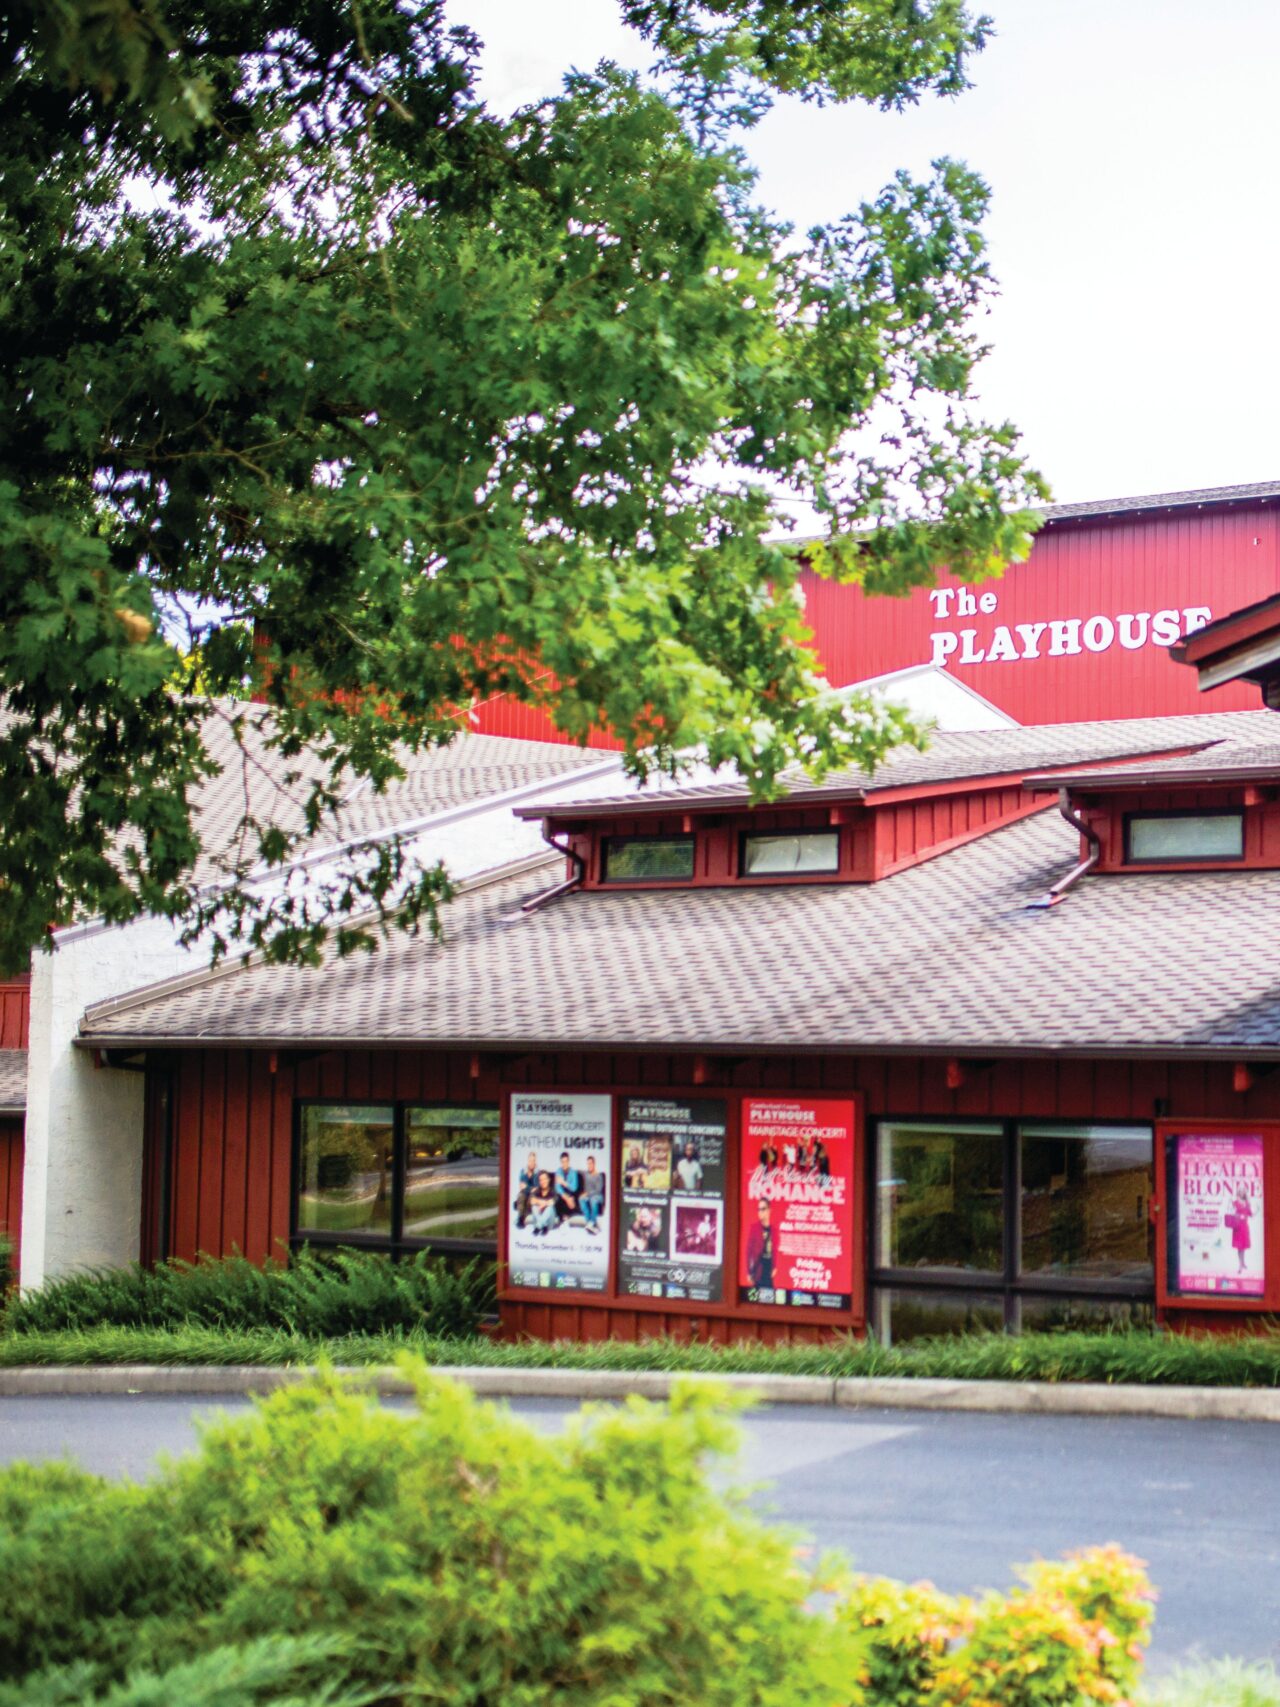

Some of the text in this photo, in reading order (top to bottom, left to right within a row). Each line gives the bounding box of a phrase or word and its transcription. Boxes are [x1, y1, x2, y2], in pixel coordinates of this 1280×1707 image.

[929, 586, 998, 618] The
[929, 606, 1213, 667] PLAYHOUSE
[516, 1104, 573, 1113] PLAYHOUSE
[628, 1107, 690, 1118] PLAYHOUSE
[750, 1110, 815, 1120] PLAYHOUSE
[515, 1121, 561, 1130] MAINSTAGE
[748, 1125, 798, 1136] MAINSTAGE
[516, 1136, 605, 1149] ANTHEM LIGHTS
[1184, 1161, 1260, 1177] LEGALLY
[748, 1180, 846, 1204] ROMANCE
[1184, 1179, 1263, 1198] BLONDE
